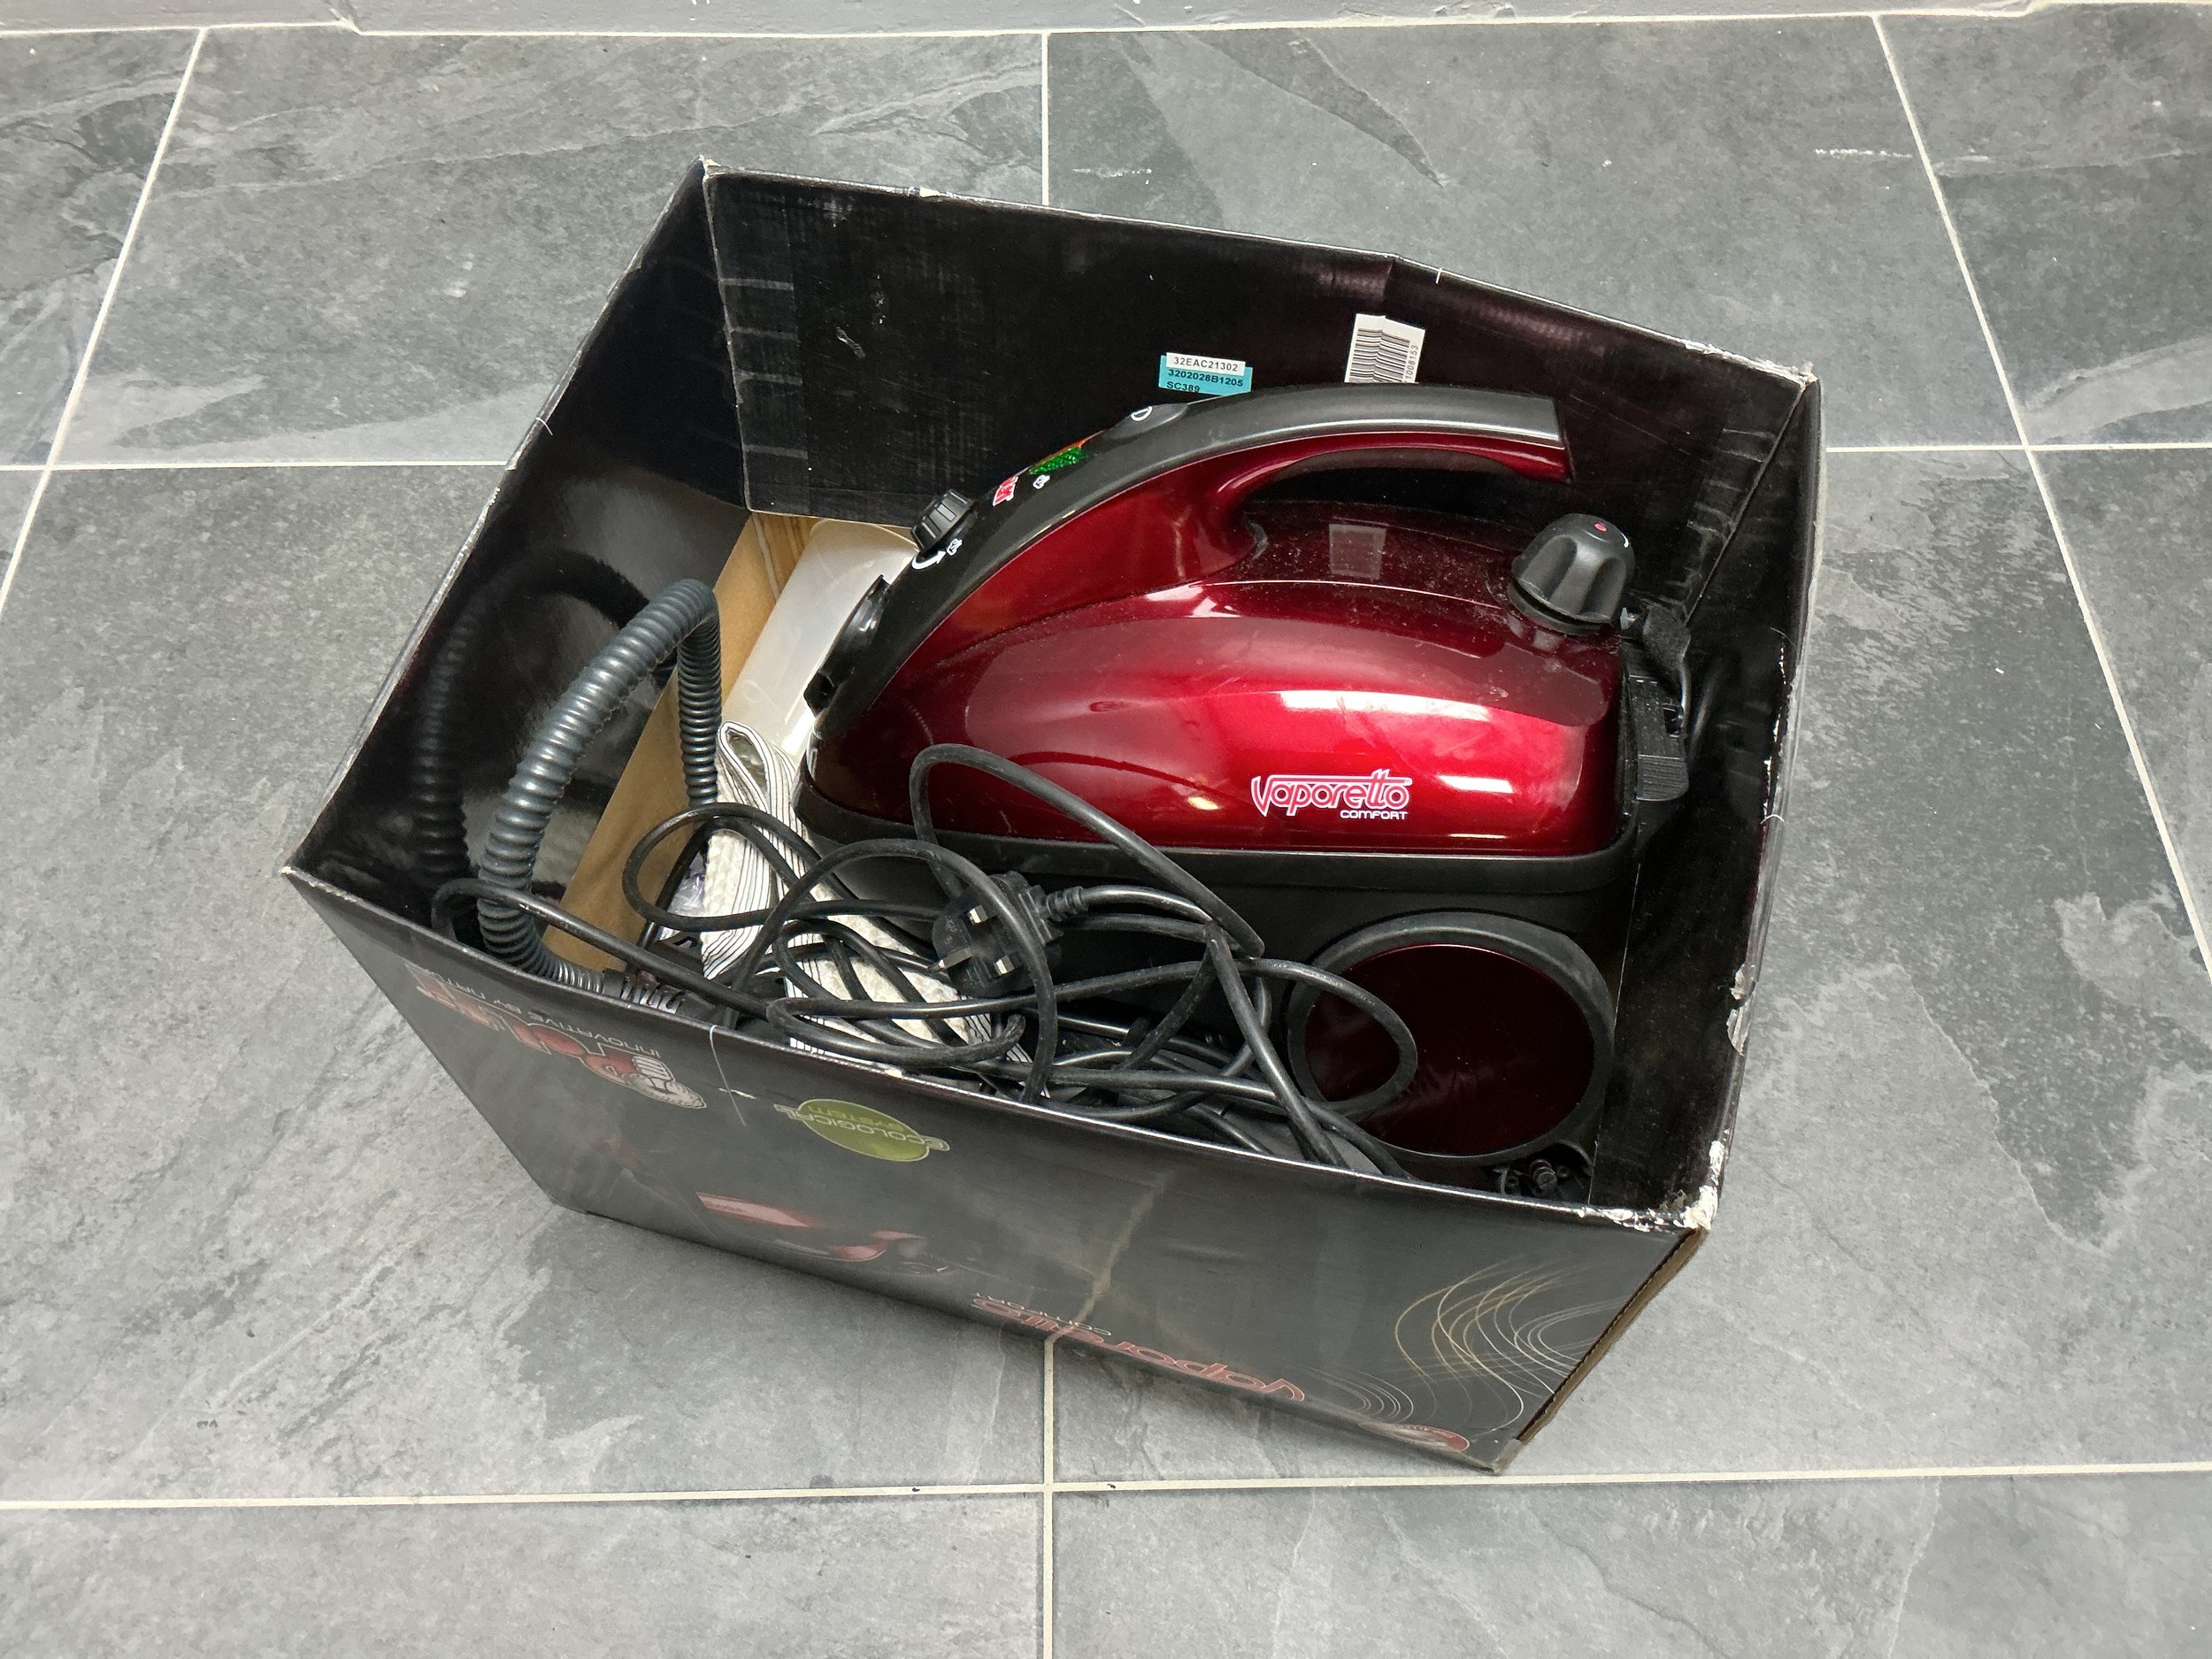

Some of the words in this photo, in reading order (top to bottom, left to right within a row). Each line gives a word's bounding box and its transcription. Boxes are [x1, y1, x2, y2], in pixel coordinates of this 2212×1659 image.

[1173, 357, 1239, 372] 32EAC21302
[1168, 369, 1244, 387] 3202028B1205
[1166, 381, 1201, 393] SC389
[1251, 768, 1413, 818] Vaporetto
[1340, 810, 1409, 820] COMFORT
